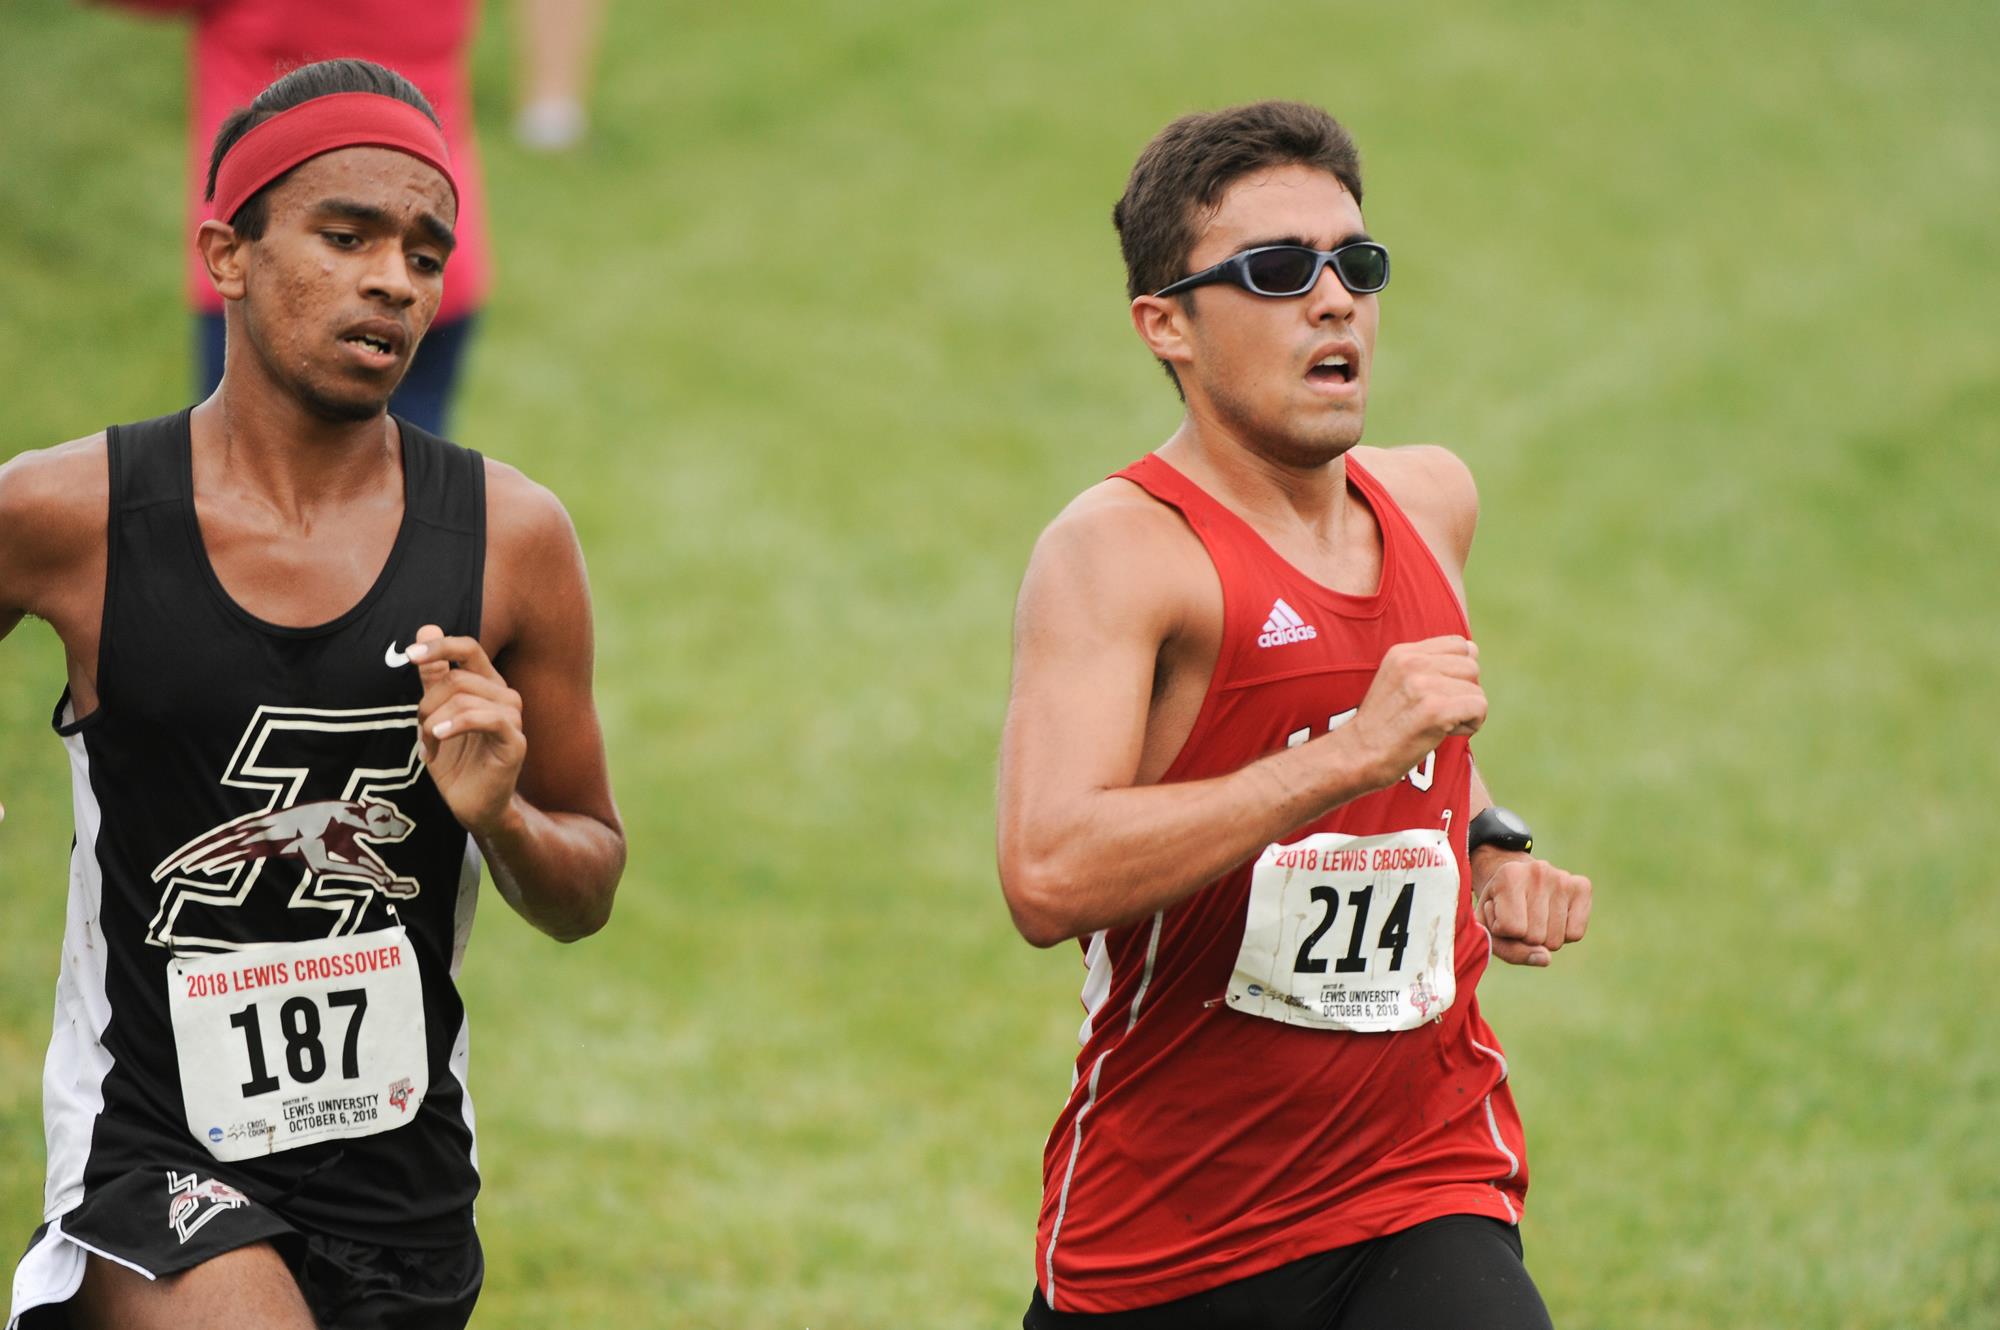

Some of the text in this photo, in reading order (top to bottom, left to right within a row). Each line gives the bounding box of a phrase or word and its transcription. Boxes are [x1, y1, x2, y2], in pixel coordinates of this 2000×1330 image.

[1258, 623, 1317, 648] adidas
[1276, 849, 1317, 871] 2018
[1323, 848, 1367, 871] LEWIS
[1294, 882, 1415, 974] 214
[187, 946, 401, 998] 2018 LEWIS CROSSOVER
[1320, 991, 1346, 1003] LEWIS
[1349, 990, 1400, 1003] UNIVERSITY
[1323, 1004, 1399, 1019] OCTOBER 6, 2018
[229, 987, 368, 1099] 187
[283, 1094, 379, 1121] LEWIS UNIVERSITY
[289, 1107, 378, 1133] OCTOBER 6, 2018
